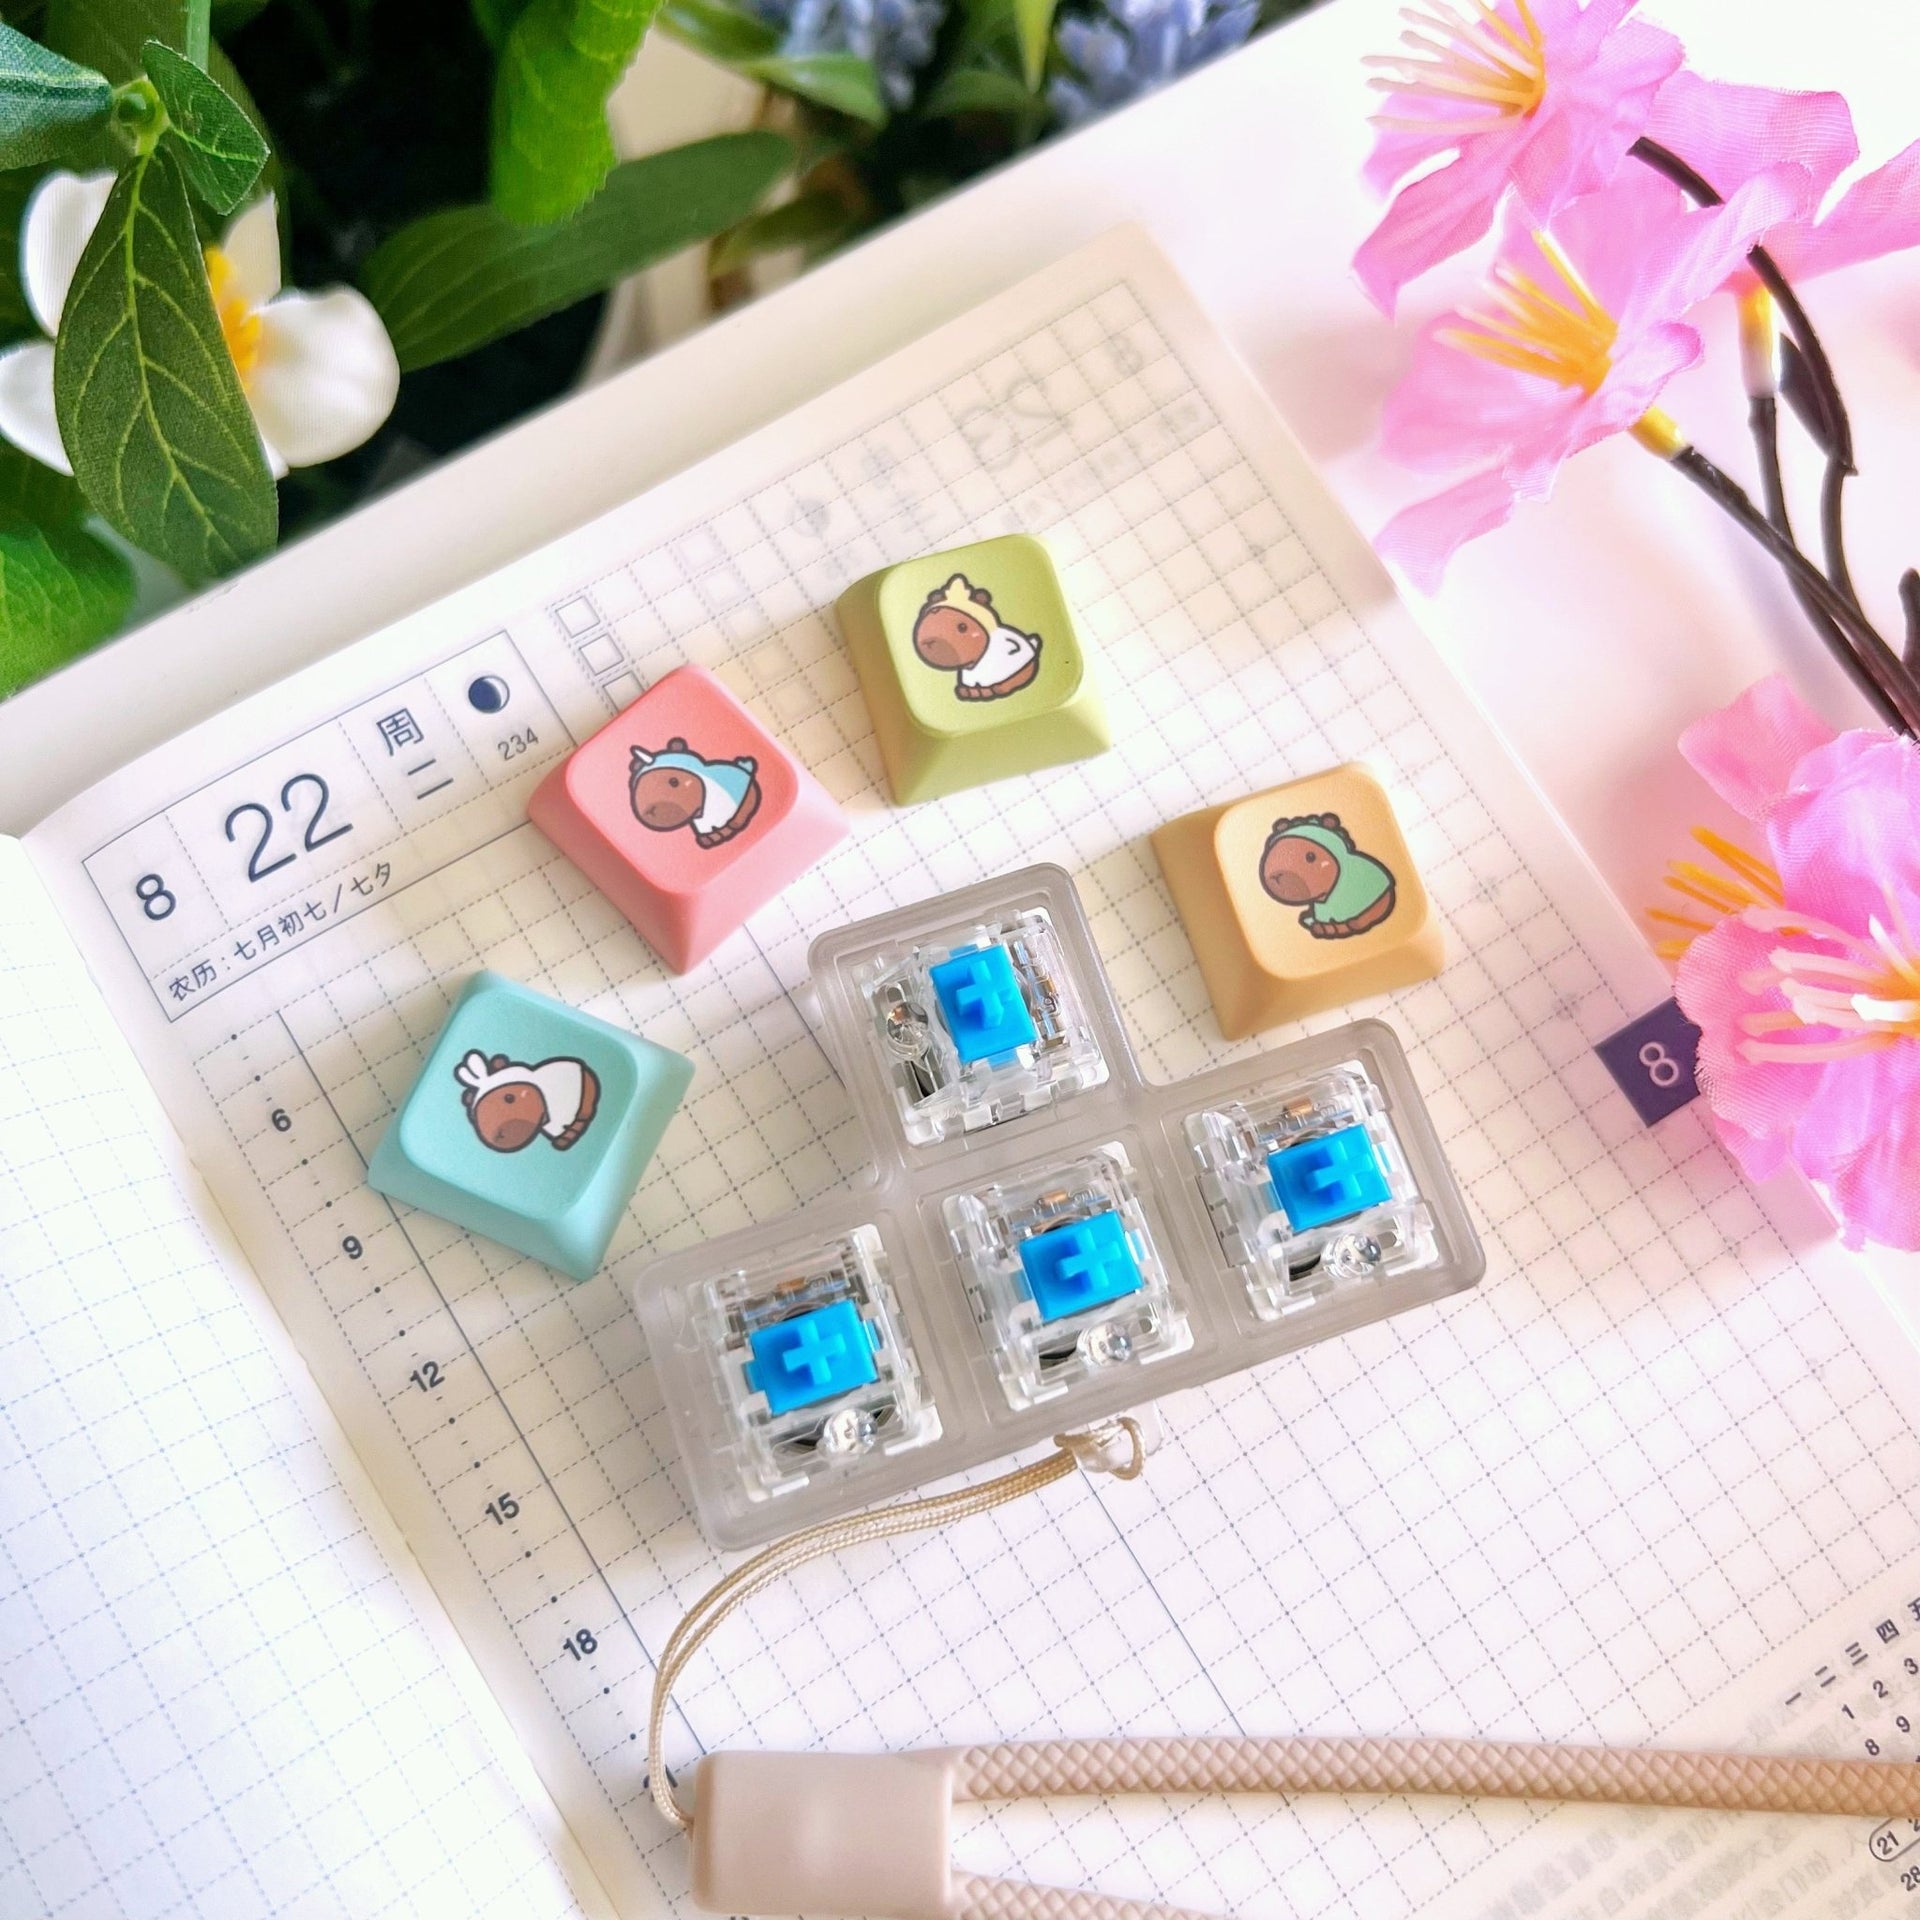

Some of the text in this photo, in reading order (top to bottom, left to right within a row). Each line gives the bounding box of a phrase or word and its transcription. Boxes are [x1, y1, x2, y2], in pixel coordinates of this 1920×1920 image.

[375, 707, 454, 801] 周二
[496, 727, 540, 761] 234
[224, 772, 354, 884] 22
[135, 873, 177, 922] 8
[1638, 1040, 1680, 1087] 8
[271, 1107, 292, 1133] 6
[341, 1235, 364, 1260] 9
[409, 1360, 446, 1393] 12
[483, 1491, 521, 1527] 15
[562, 1628, 599, 1662] 18
[1814, 1665, 1837, 1688] 二
[1844, 1641, 1869, 1667] 三
[1875, 1618, 1900, 1644] 四
[1841, 1657, 1919, 1720] 1 2 3
[1864, 1715, 1911, 1756] 8 9
[1876, 1830, 1900, 1856] 21
